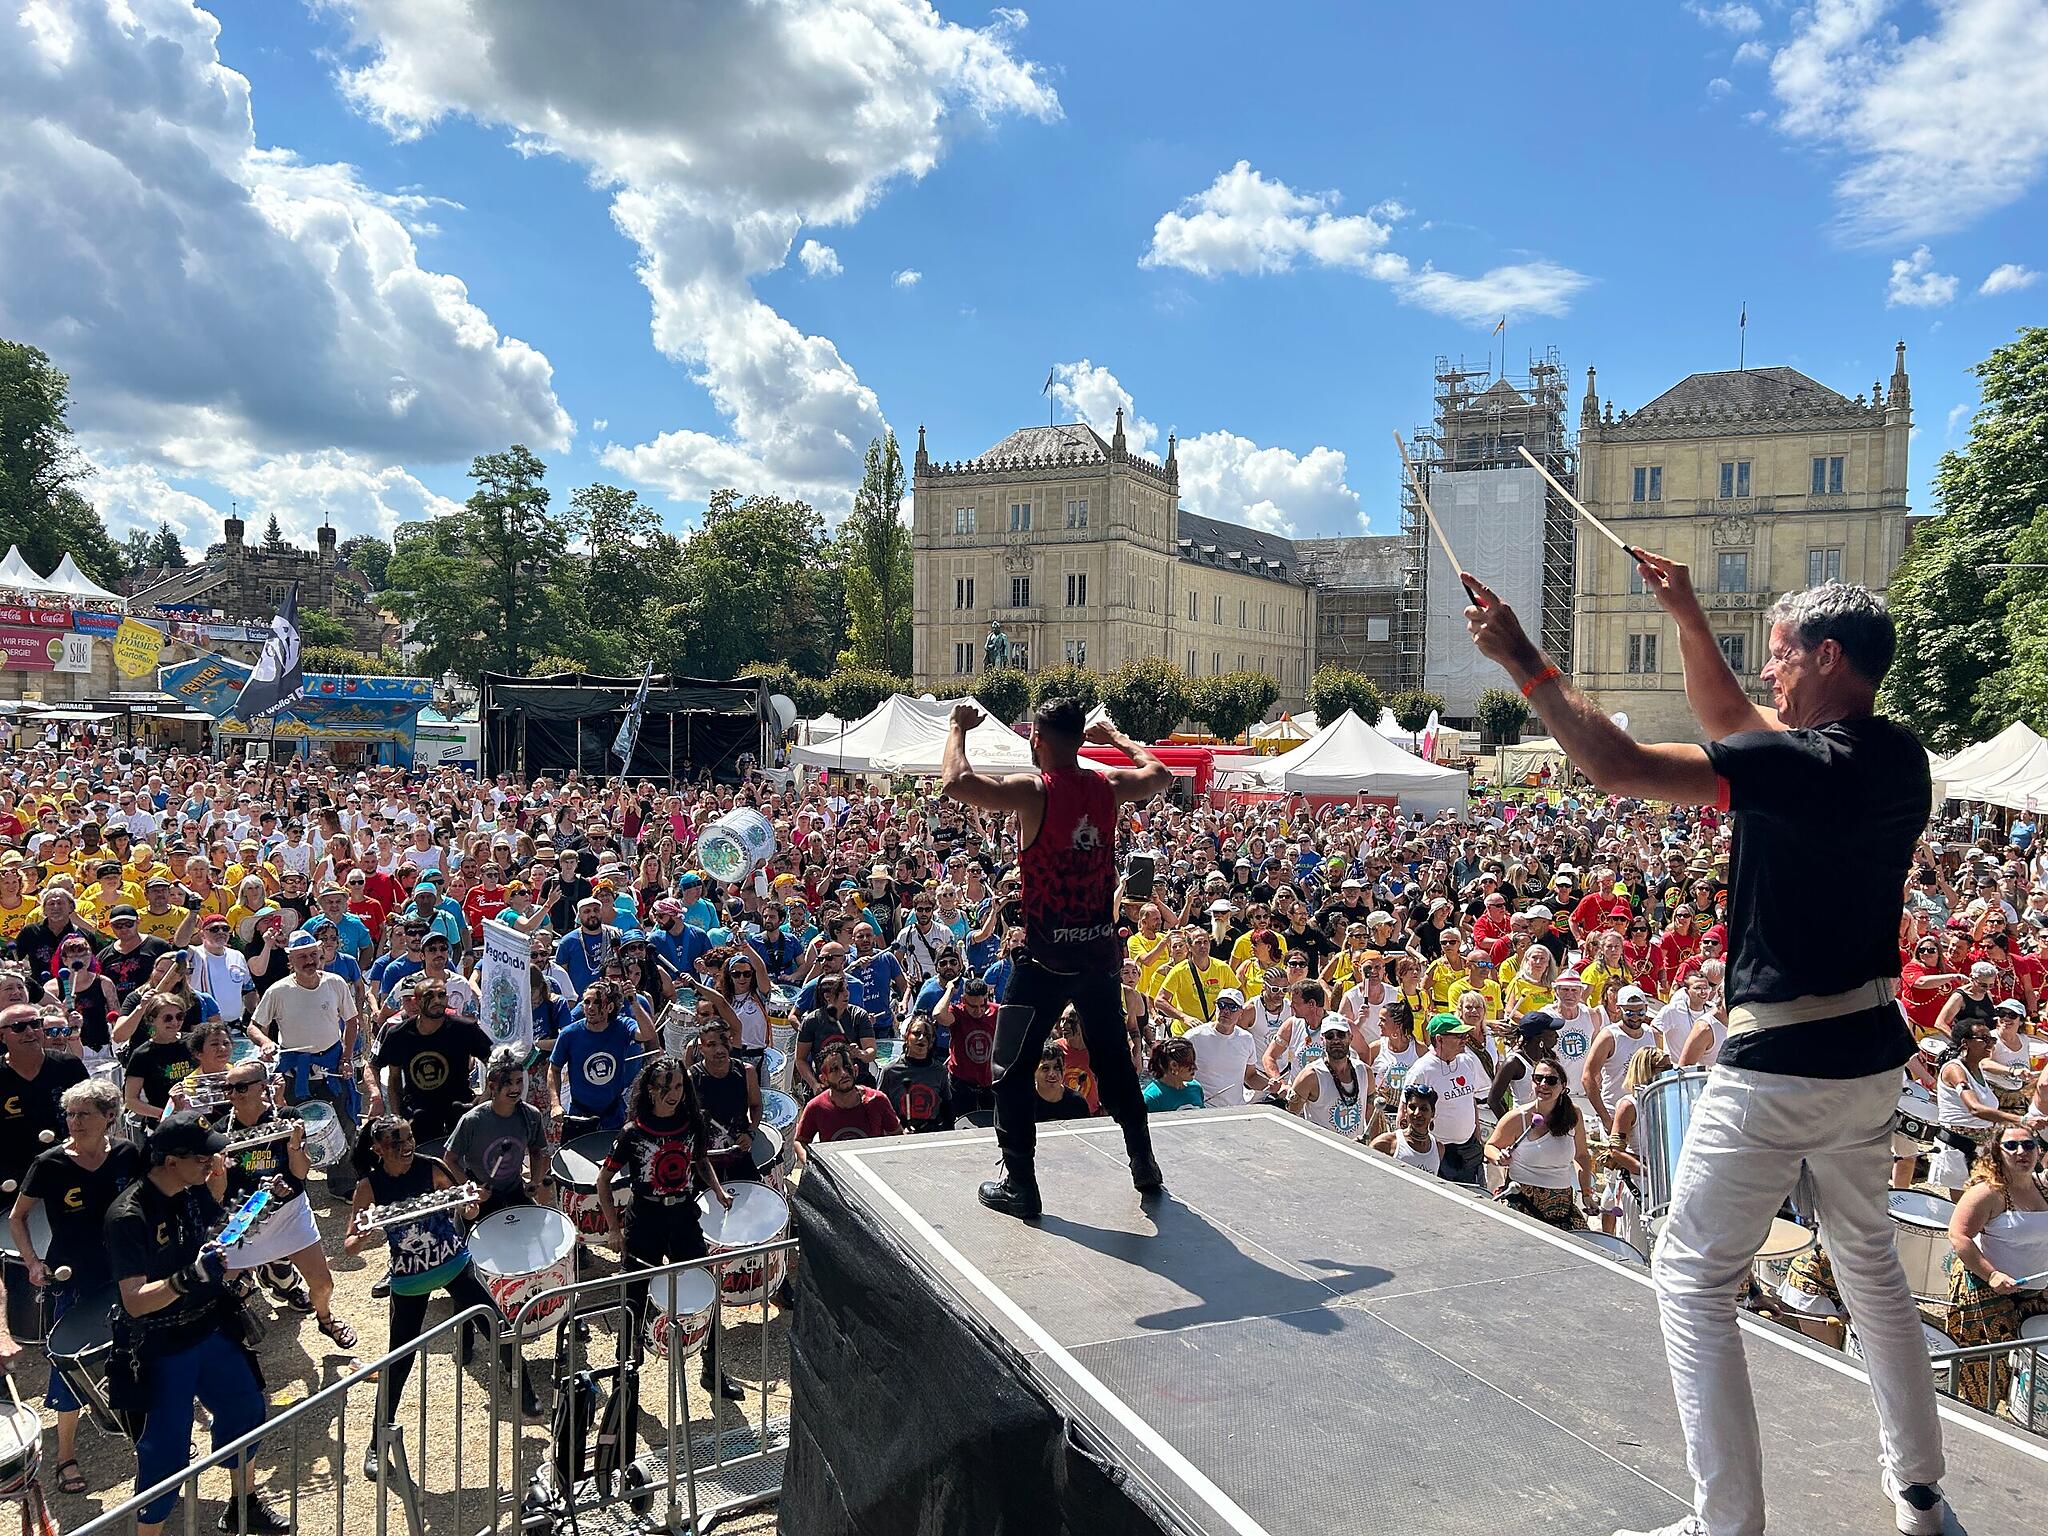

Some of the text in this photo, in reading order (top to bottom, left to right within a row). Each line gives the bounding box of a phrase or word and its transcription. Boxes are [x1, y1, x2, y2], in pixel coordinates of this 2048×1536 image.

[3, 637, 40, 647] WIR FEIERN
[119, 636, 161, 652] POMMES
[6, 648, 31, 657] NERGIE!
[117, 648, 154, 665] Kartoffeln
